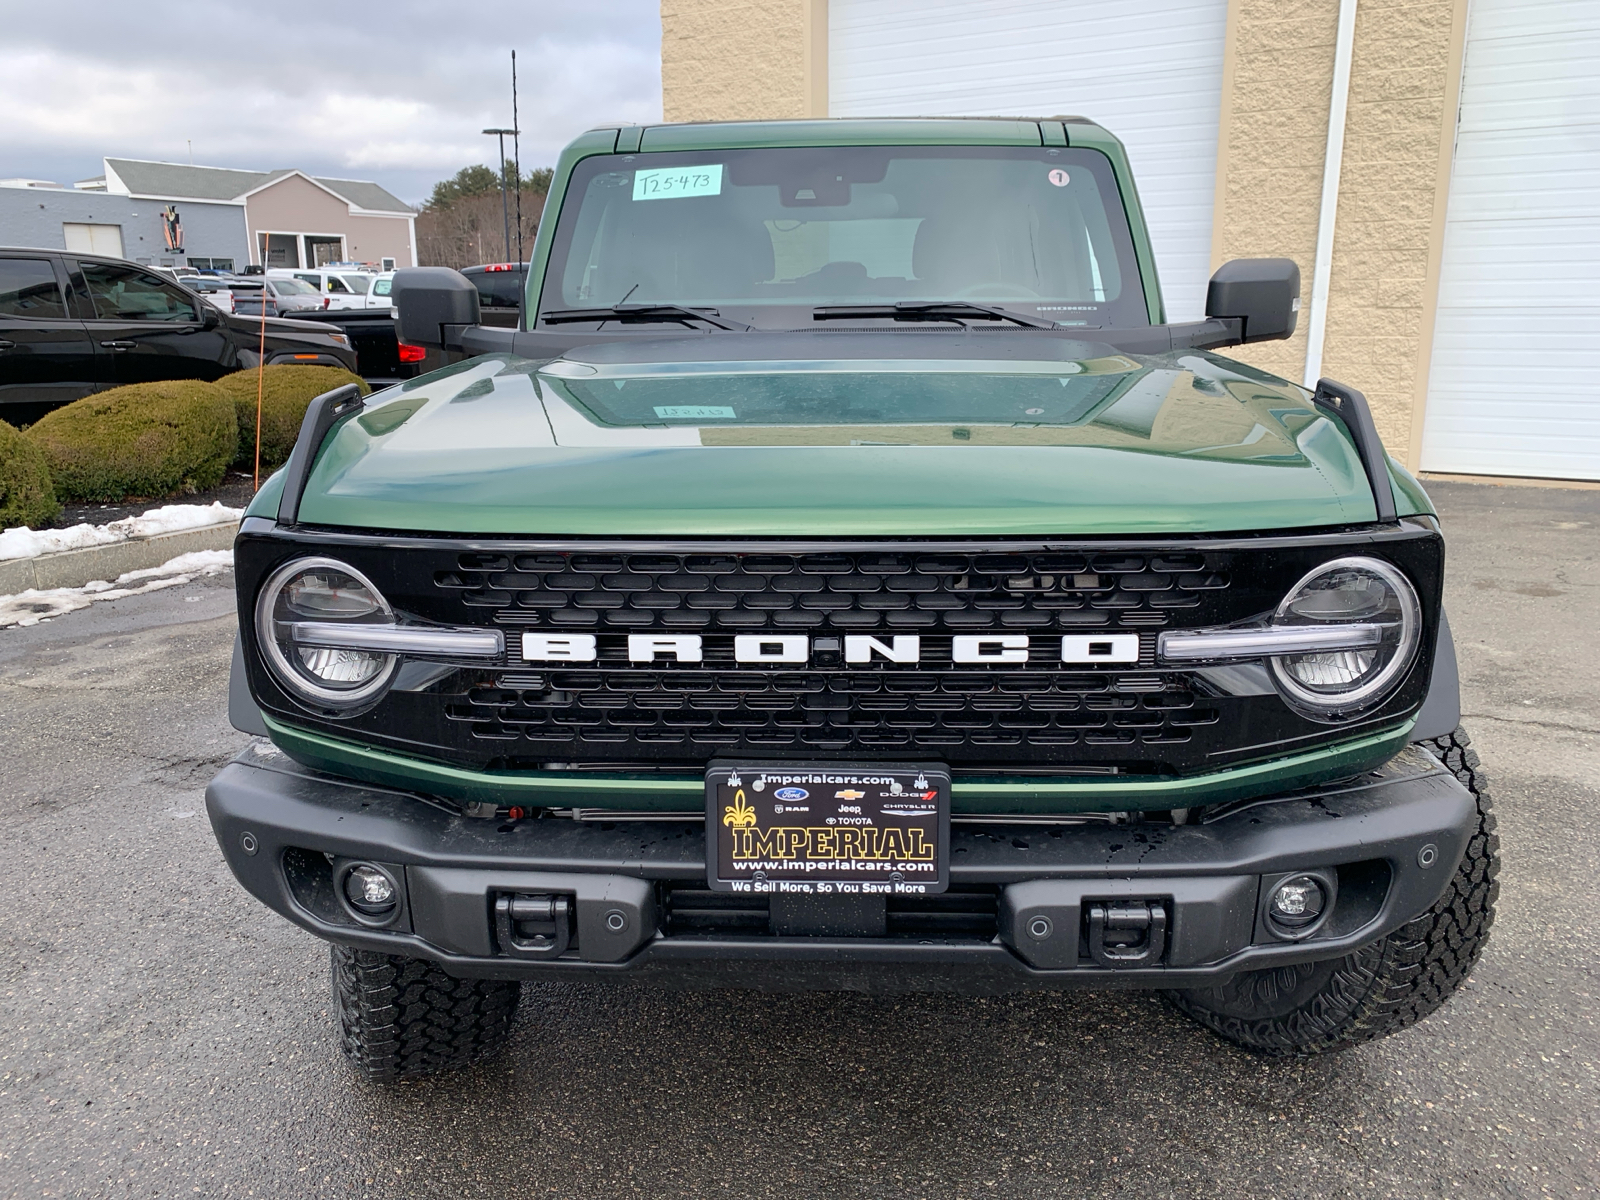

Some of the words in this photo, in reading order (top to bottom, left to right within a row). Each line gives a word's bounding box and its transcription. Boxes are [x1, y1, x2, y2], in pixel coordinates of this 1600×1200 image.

[639, 173, 710, 195] T25-473
[521, 632, 1141, 663] BRONCO
[760, 773, 895, 785] Imperialcars.com
[838, 804, 862, 815] Jeep
[838, 817, 873, 825] TOYOTA
[732, 826, 934, 860] IMPERIAL
[732, 859, 934, 872] www.imperialcars.com
[731, 881, 751, 892] We
[754, 881, 776, 892] Sell
[780, 882, 814, 894] More,
[816, 882, 833, 892] So
[836, 882, 859, 893] You
[862, 883, 892, 893] Save
[895, 883, 926, 893] More
